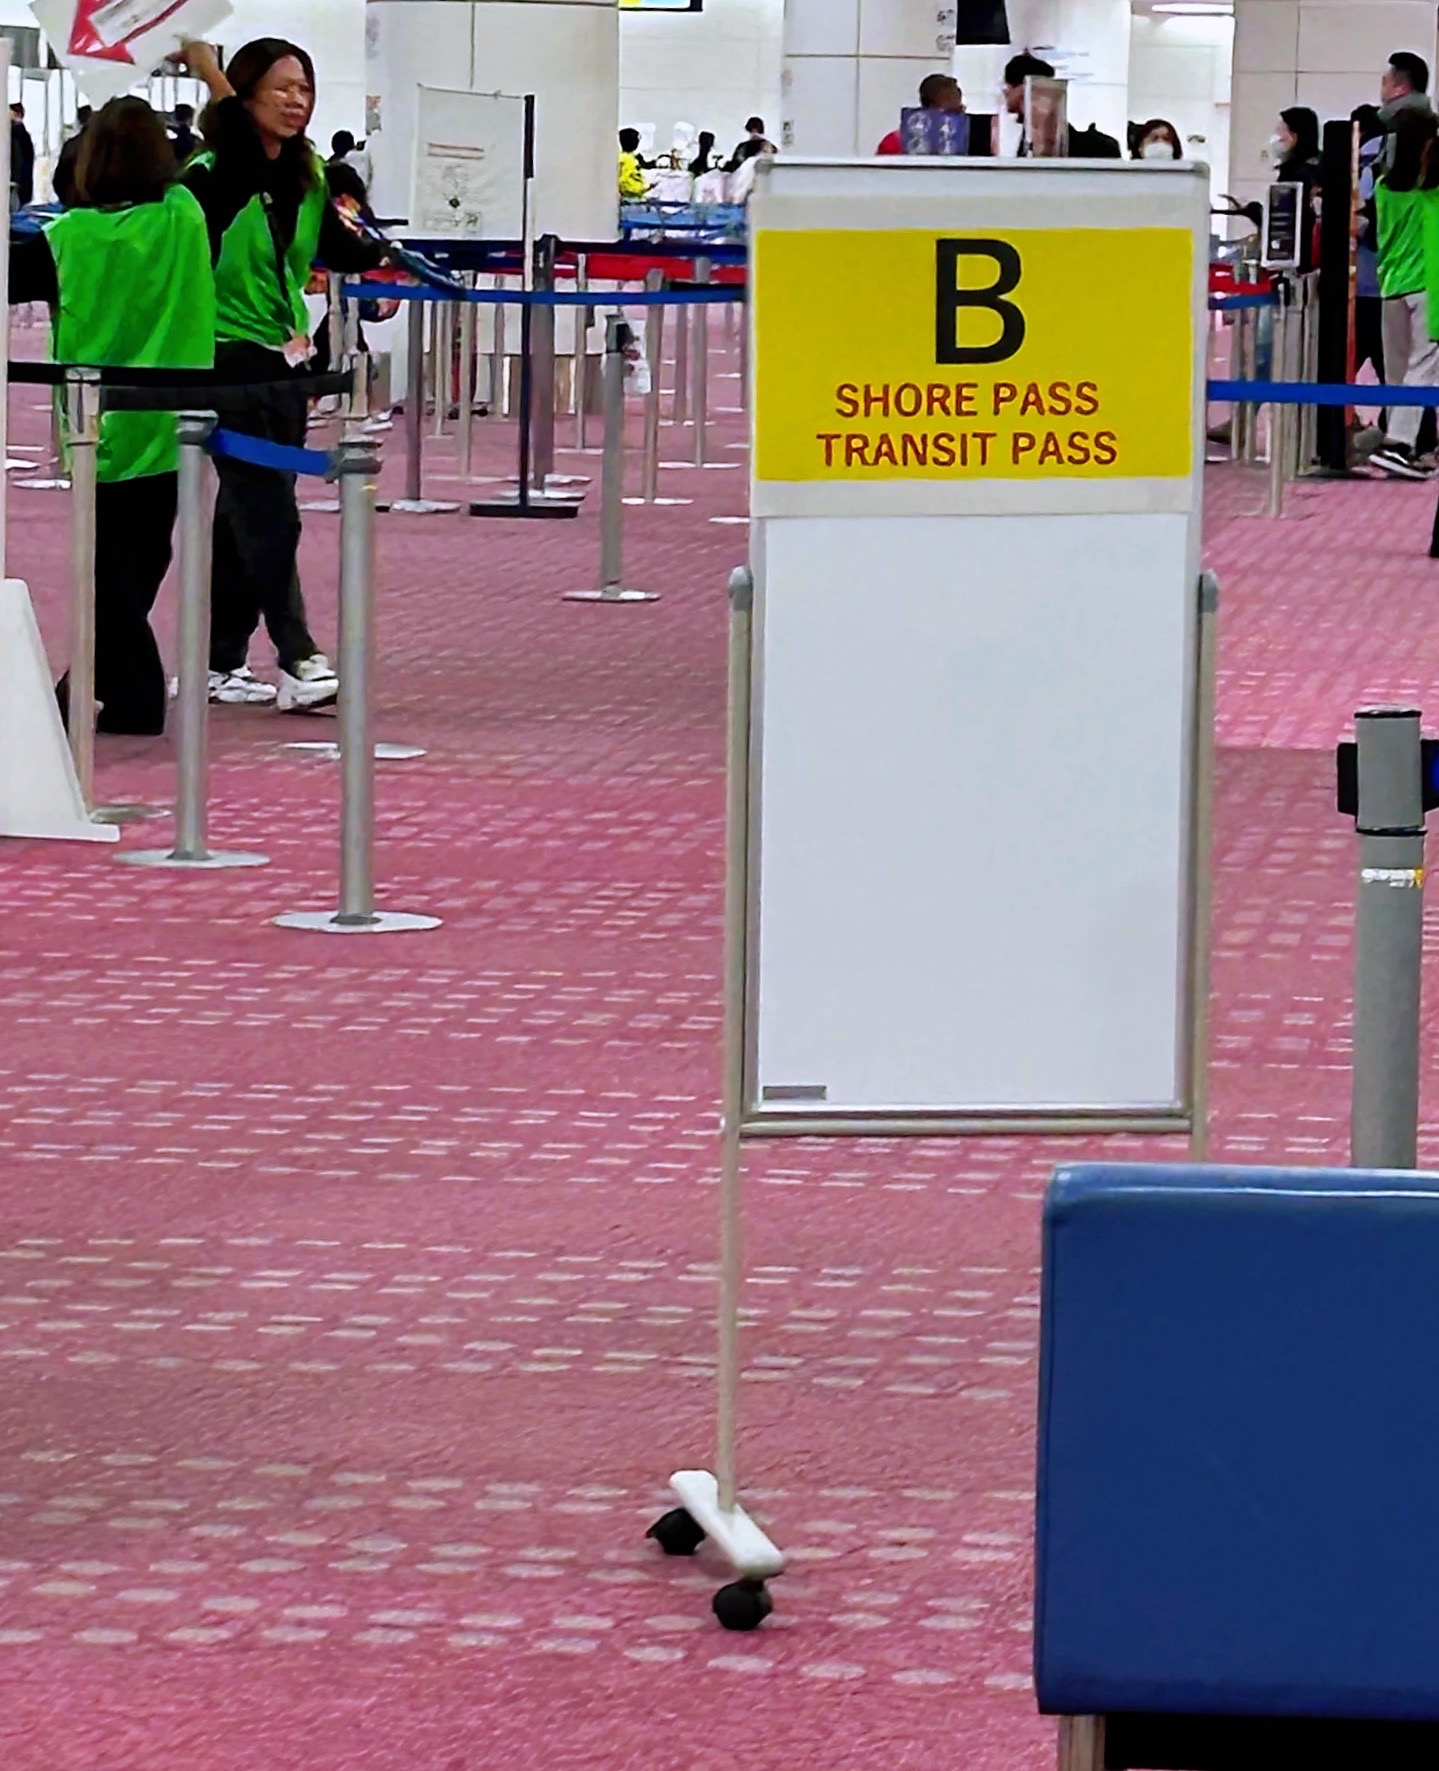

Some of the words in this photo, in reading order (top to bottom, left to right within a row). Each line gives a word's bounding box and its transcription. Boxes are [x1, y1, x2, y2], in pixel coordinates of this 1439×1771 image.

[935, 238, 1025, 364] B
[835, 382, 979, 418] SHORE
[993, 381, 1100, 417] PASS
[816, 432, 998, 467] TRANSIT
[1012, 430, 1118, 465] PASS
